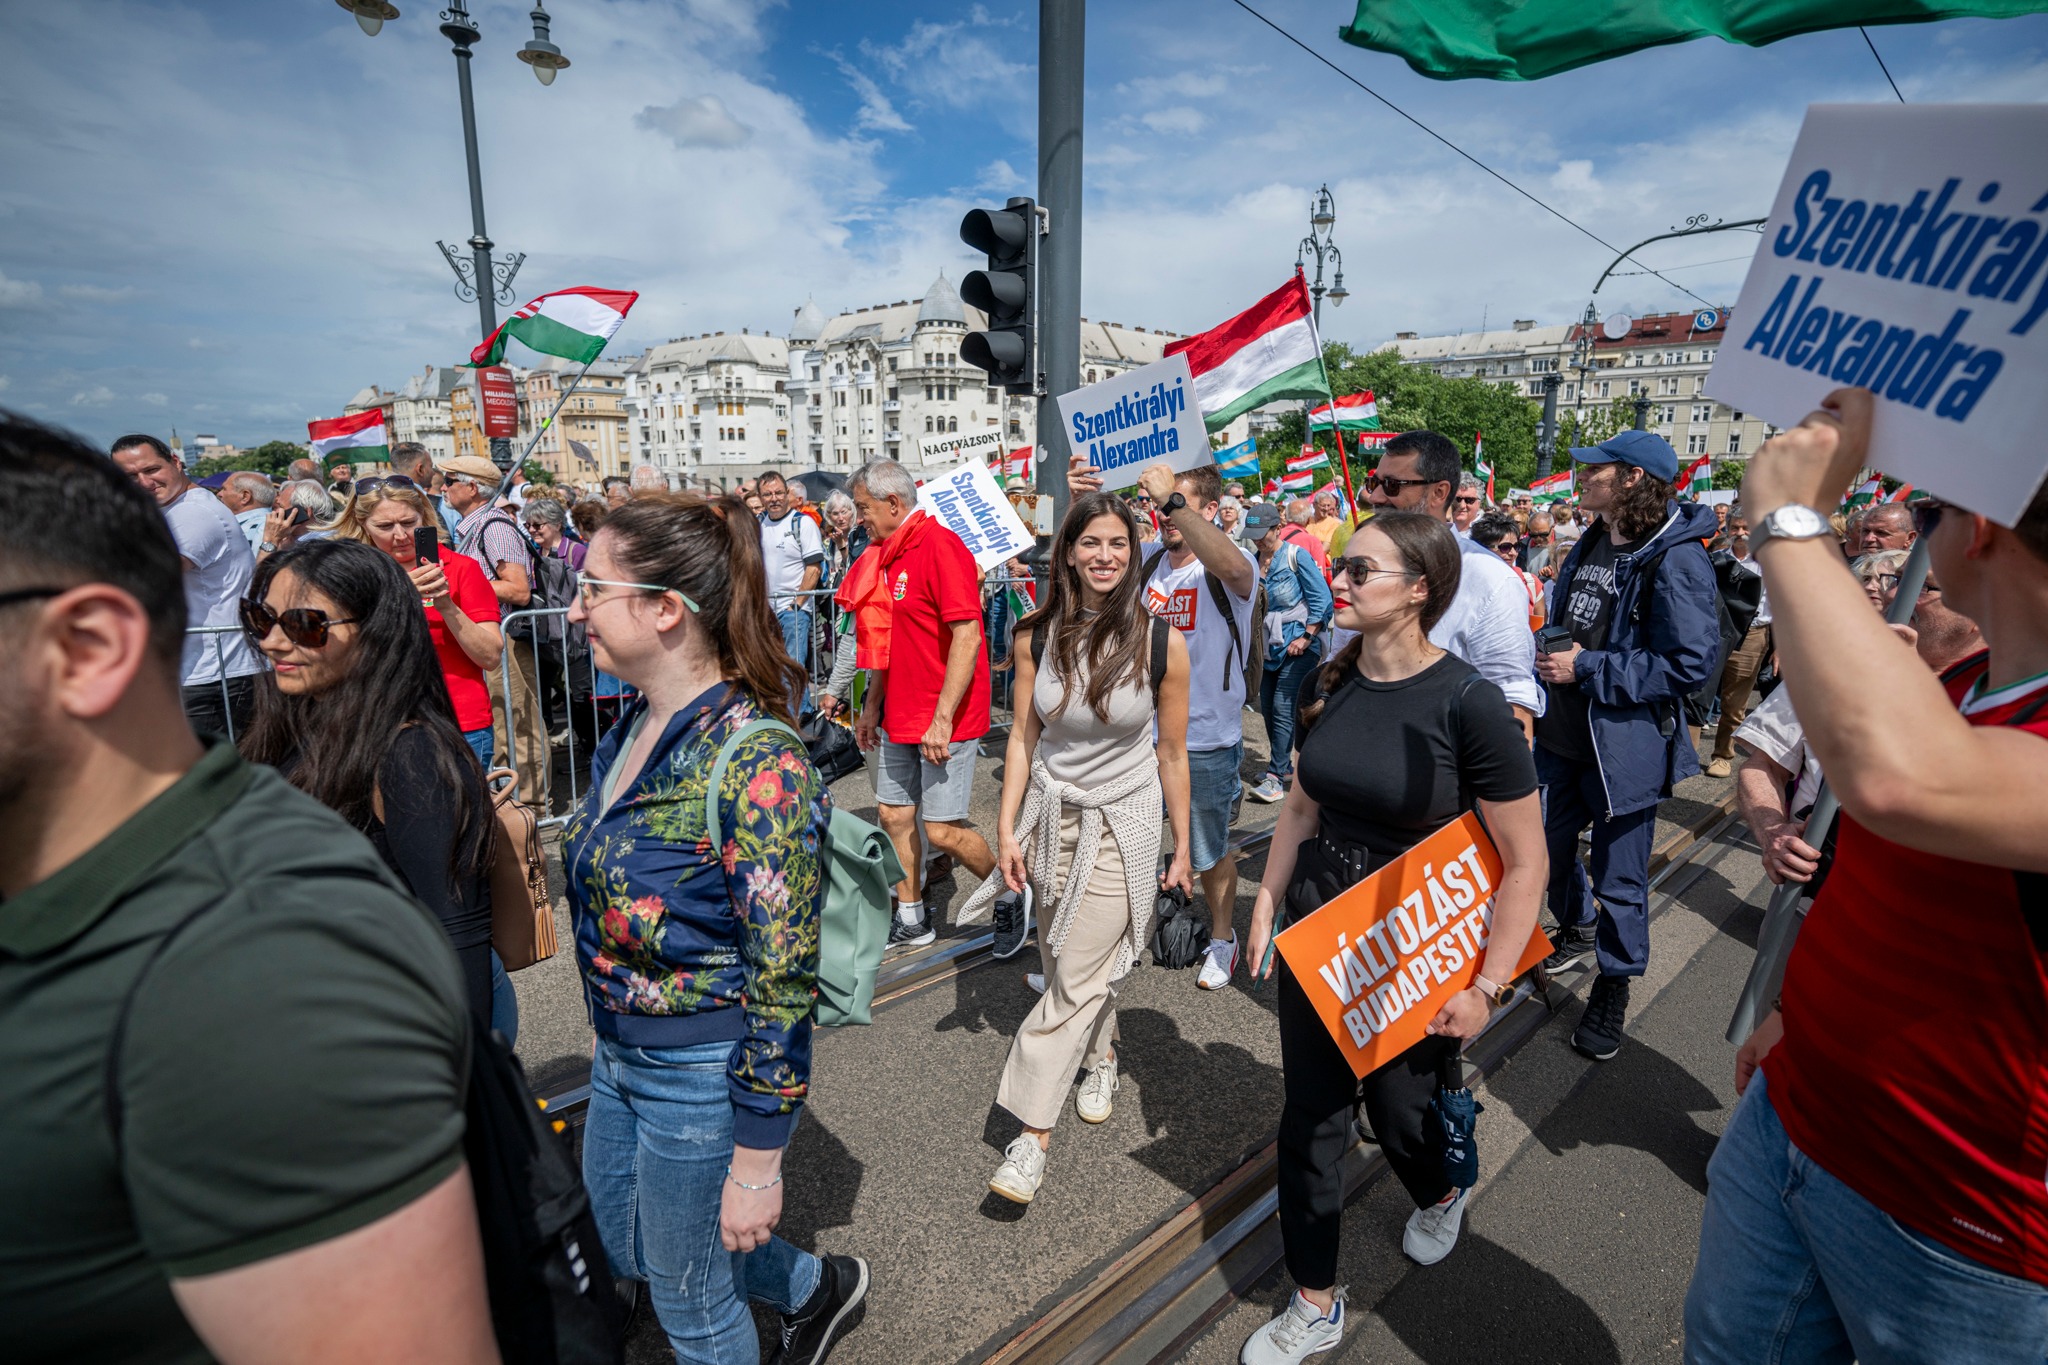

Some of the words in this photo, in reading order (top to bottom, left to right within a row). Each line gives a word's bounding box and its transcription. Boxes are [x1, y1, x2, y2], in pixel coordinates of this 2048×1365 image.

[1743, 274, 2006, 423] Alexandra
[484, 390, 516, 399] MILLIÁRDOS
[486, 397, 516, 407] MEGOLDÁS
[1072, 377, 1185, 443] Szentkirályi
[923, 432, 1001, 456] NAGYVÁZSONY
[1089, 423, 1180, 475] Alexandra
[930, 489, 984, 555] Alexandra
[951, 471, 1019, 554] Szentkirályi
[1318, 844, 1490, 1006] VÁLTOZÁST
